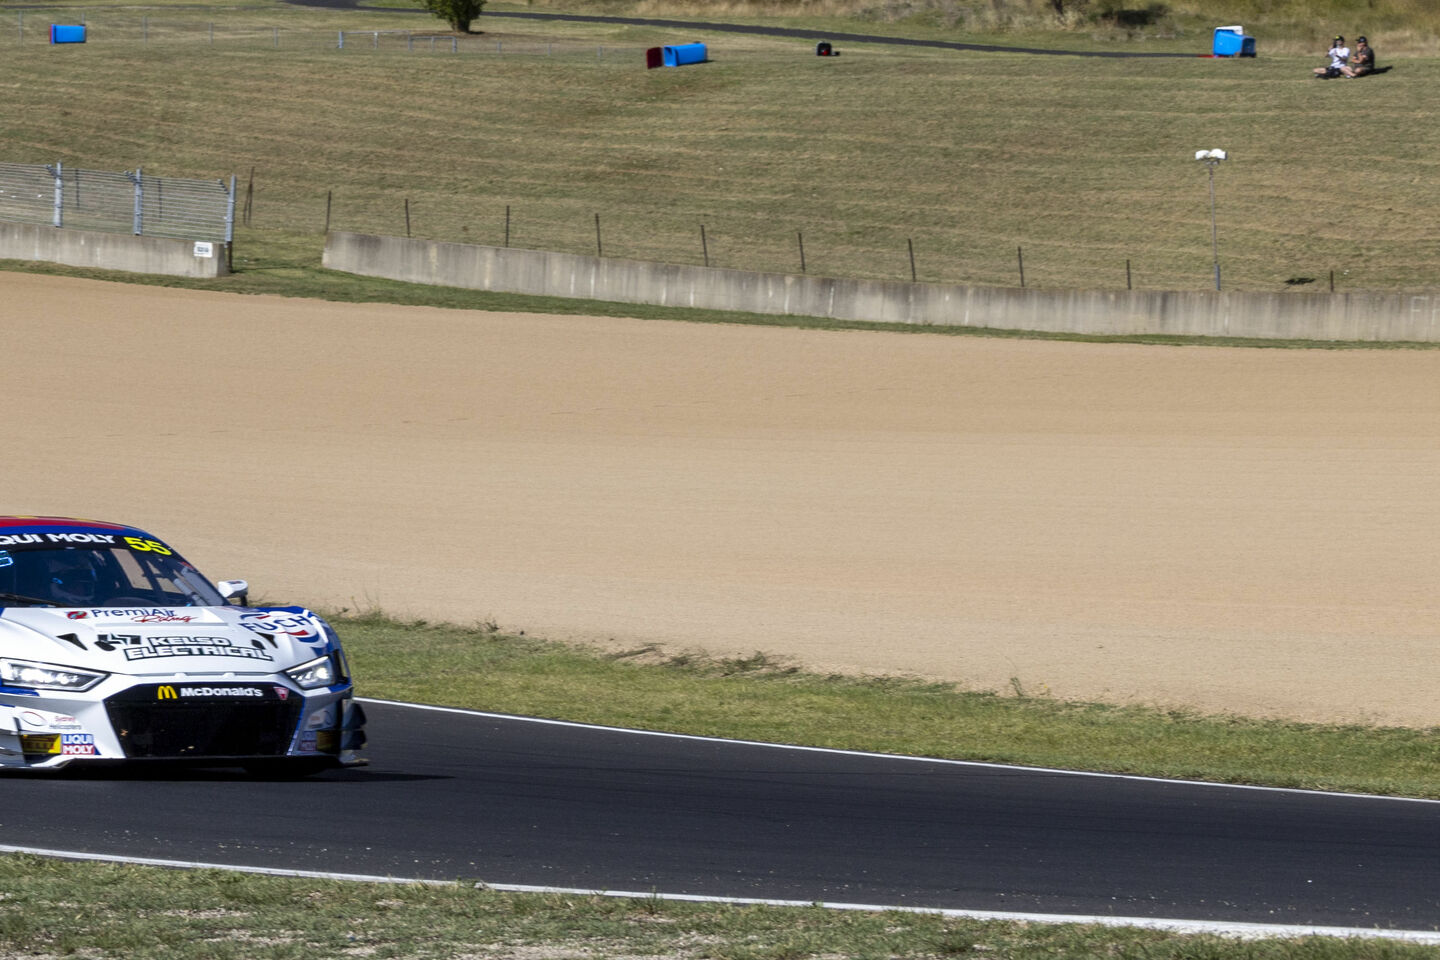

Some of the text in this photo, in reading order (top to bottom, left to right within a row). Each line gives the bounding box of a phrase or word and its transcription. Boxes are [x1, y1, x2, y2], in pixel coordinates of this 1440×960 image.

[47, 533, 116, 544] MOLY
[123, 537, 172, 555] 55
[91, 609, 177, 618] PremiAir
[238, 615, 314, 632] FUCH
[147, 636, 232, 648] KELSO
[123, 645, 274, 662] ELECTRICAL
[180, 687, 263, 698] McDonald's
[62, 734, 93, 744] LIQUI
[62, 745, 93, 754] MOLY
